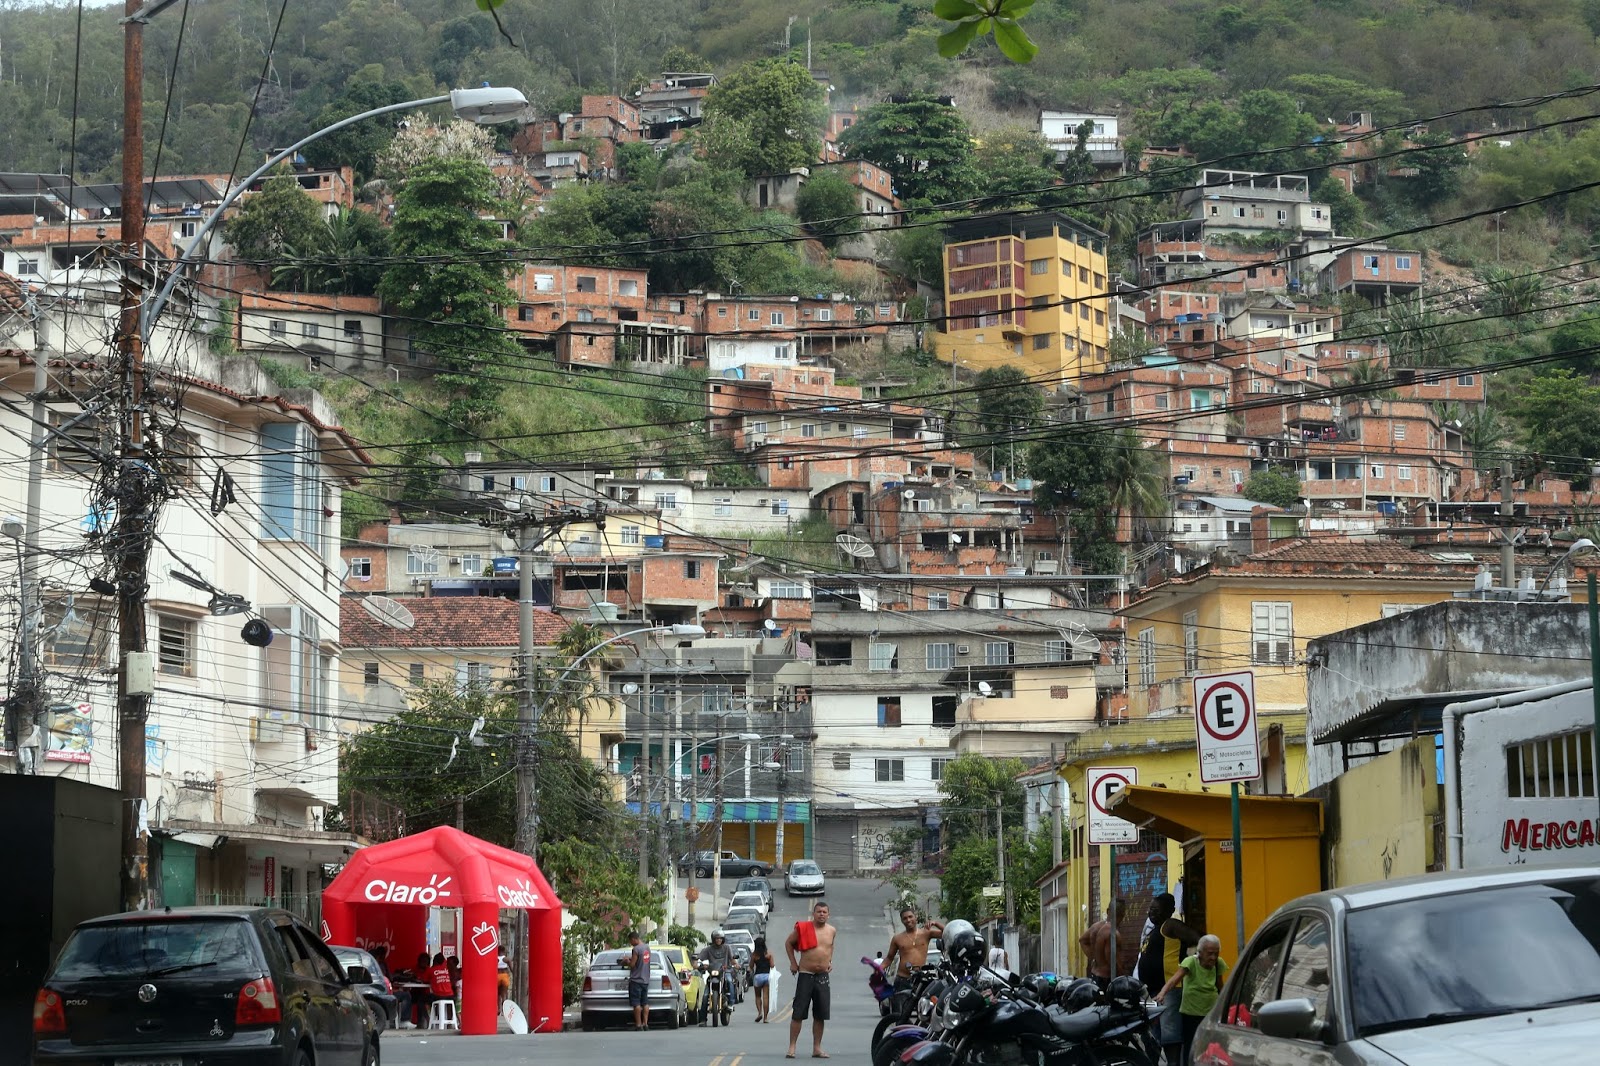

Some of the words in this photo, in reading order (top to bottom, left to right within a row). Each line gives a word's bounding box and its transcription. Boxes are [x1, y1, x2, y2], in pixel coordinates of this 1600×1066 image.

[1215, 694, 1234, 728] E
[1219, 750, 1252, 758] Motocicletas
[1501, 818, 1600, 853] MERCA
[364, 879, 437, 904] Claro
[497, 884, 535, 908] Claro
